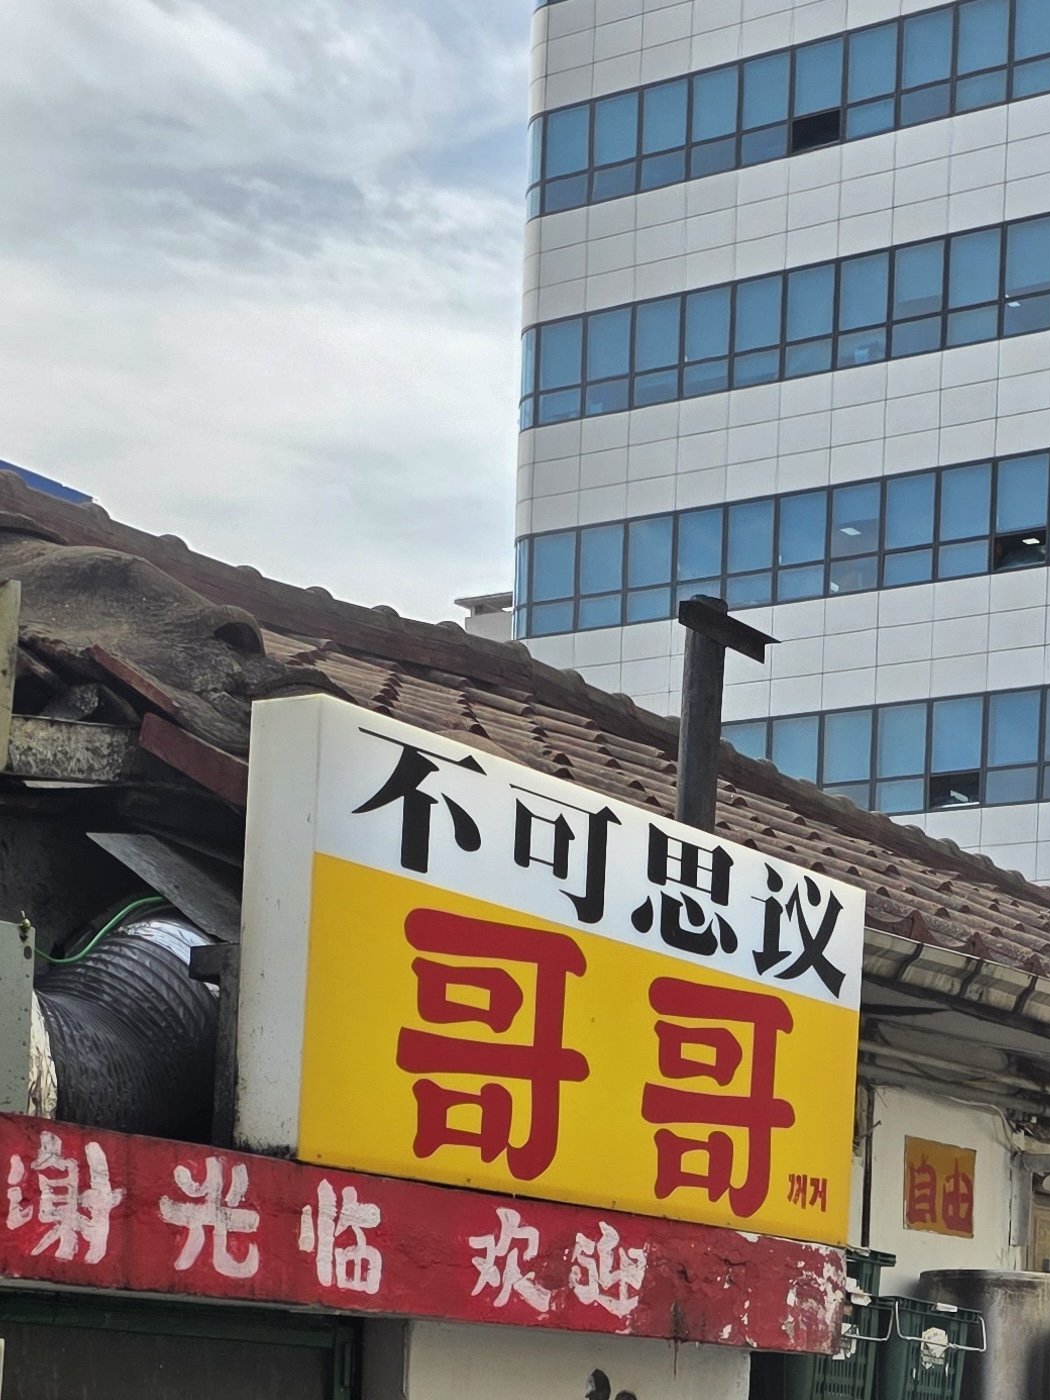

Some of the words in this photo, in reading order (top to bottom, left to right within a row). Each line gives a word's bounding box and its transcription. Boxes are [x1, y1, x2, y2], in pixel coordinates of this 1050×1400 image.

[351, 727, 846, 999] 不可思议
[396, 908, 796, 1219] 哥哥
[469, 1207, 647, 1318] 欢迎
